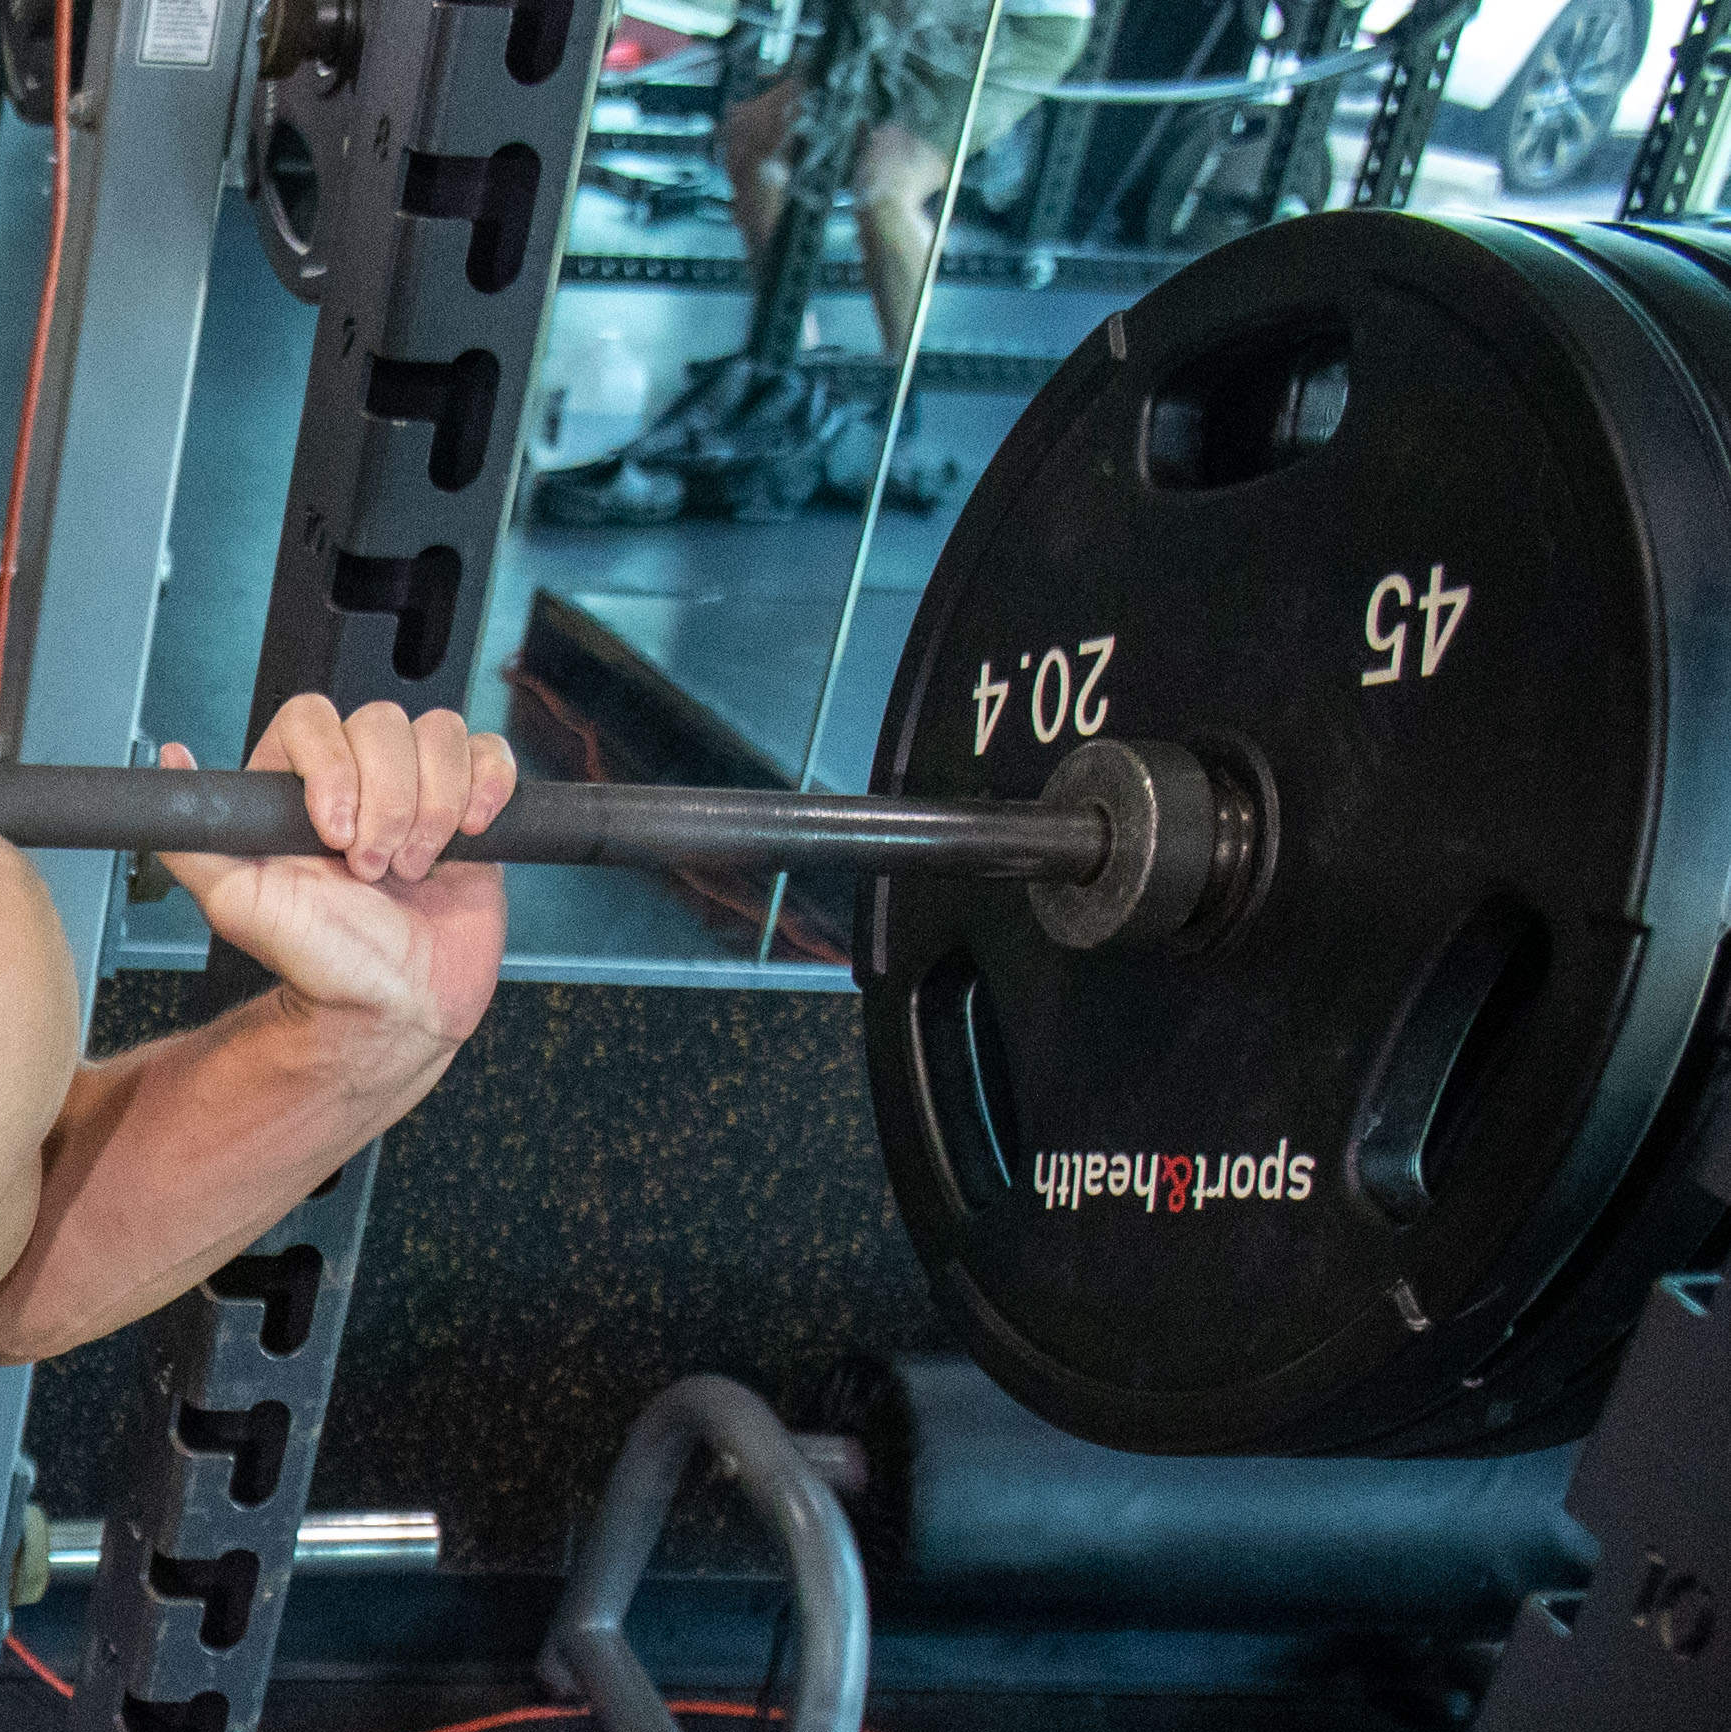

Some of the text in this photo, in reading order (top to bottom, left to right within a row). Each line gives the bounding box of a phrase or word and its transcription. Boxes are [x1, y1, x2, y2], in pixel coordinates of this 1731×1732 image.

[1359, 564, 1473, 686] 45
[970, 635, 1116, 757] 20.4
[1033, 1137, 1316, 1214] sport&health
